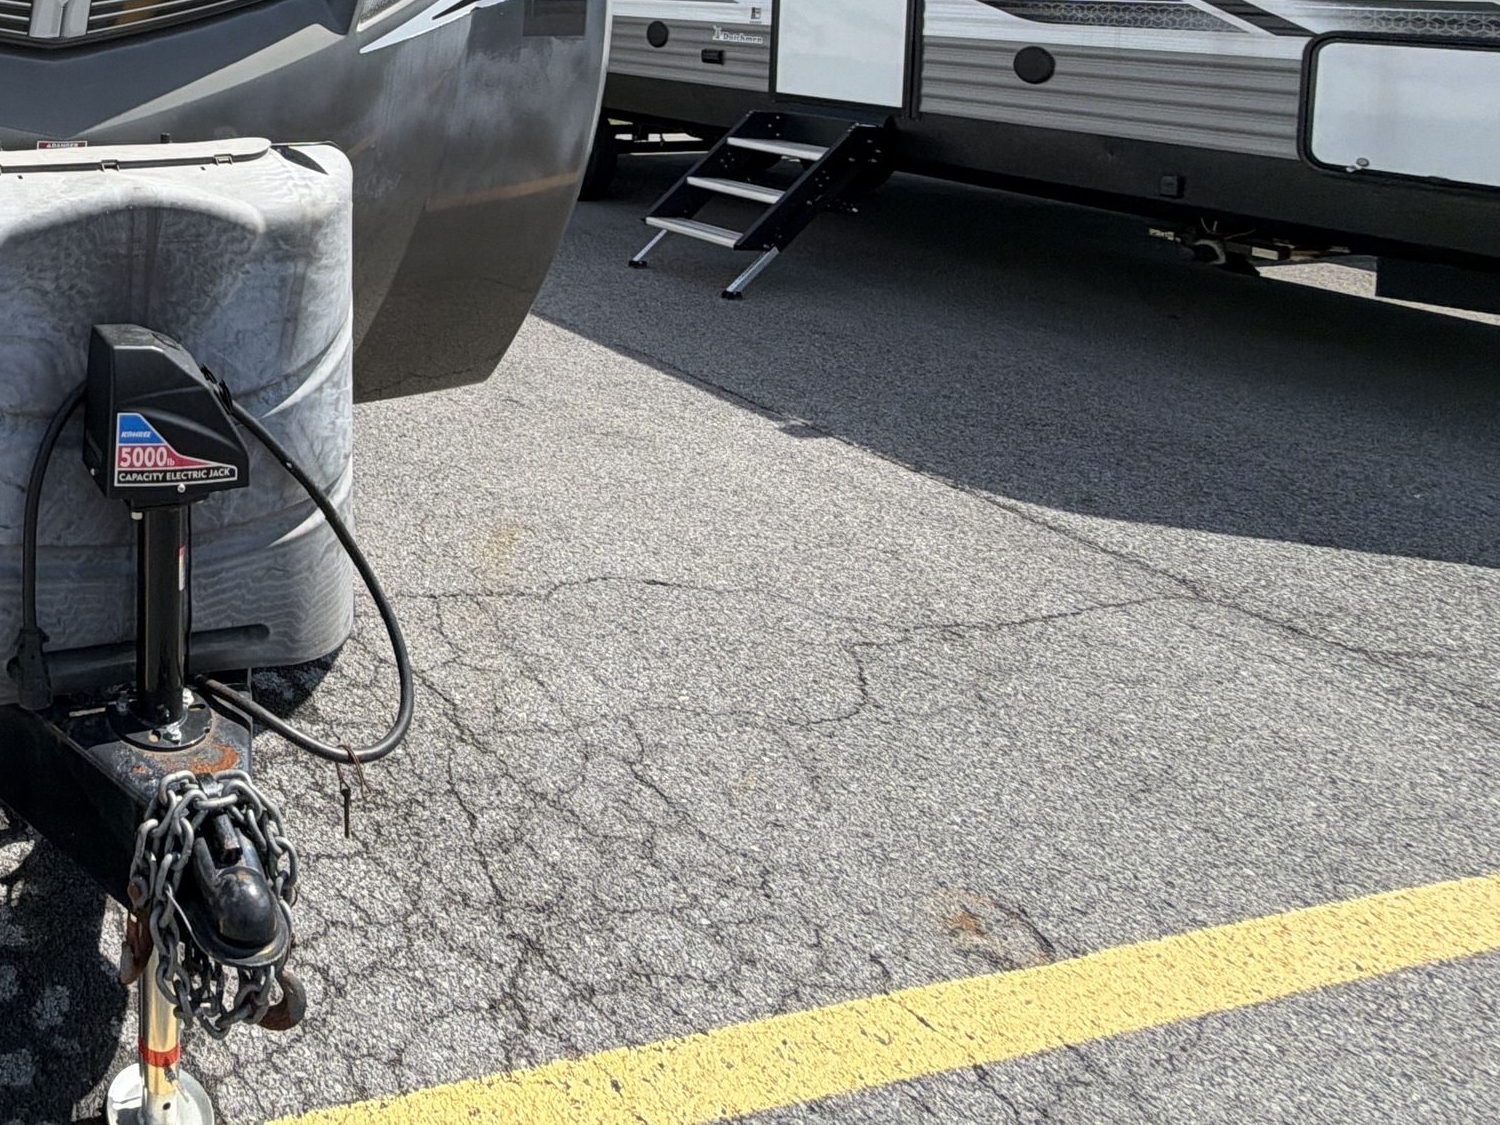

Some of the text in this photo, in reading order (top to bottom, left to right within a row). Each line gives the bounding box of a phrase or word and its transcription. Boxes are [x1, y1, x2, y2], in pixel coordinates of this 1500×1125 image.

[722, 31, 764, 44] Dutchmen
[119, 467, 231, 482] CAPACITY ELECTRIC JACK
